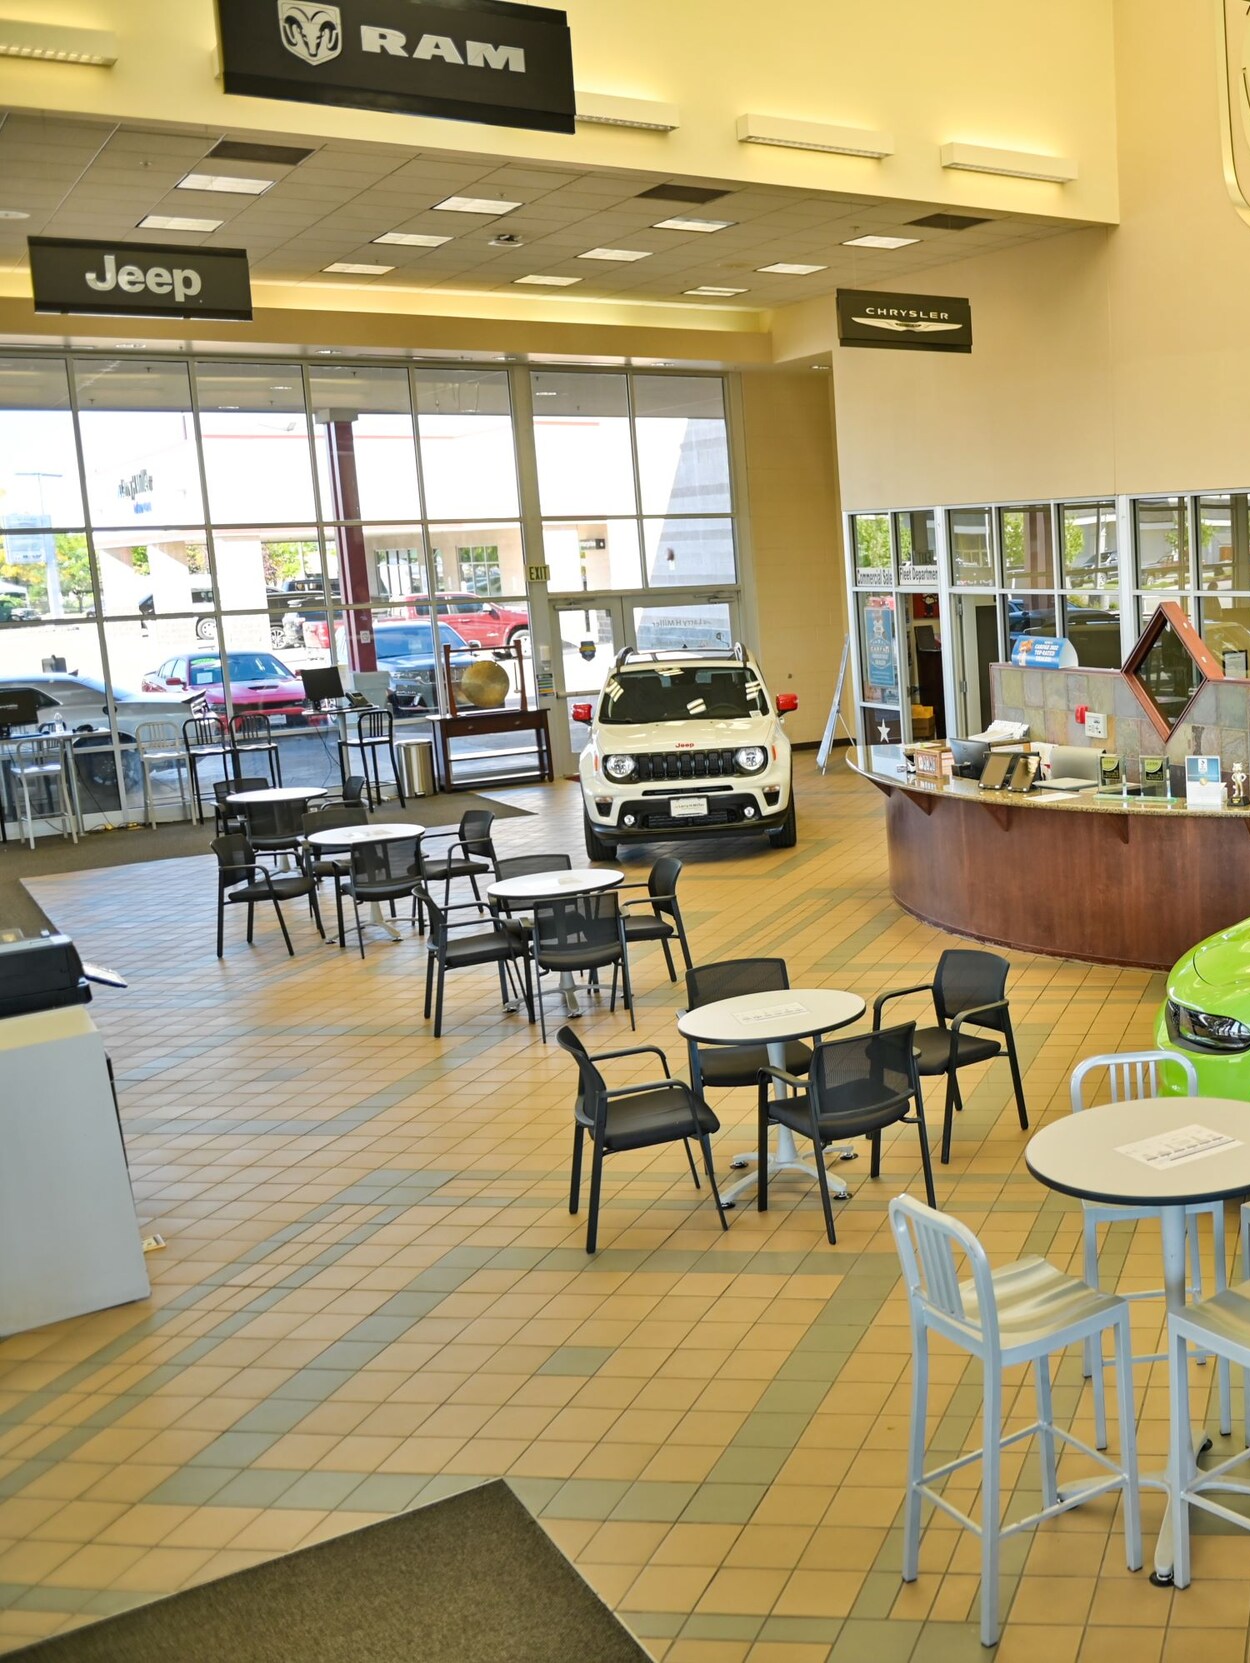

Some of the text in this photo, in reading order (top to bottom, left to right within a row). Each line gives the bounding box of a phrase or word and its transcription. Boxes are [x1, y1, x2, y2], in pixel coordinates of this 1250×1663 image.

[360, 25, 526, 73] RAM
[85, 254, 202, 302] Jeep
[865, 307, 949, 320] CHRYSLER
[529, 566, 548, 581] EXIT
[899, 566, 938, 583] Fleet Departmen
